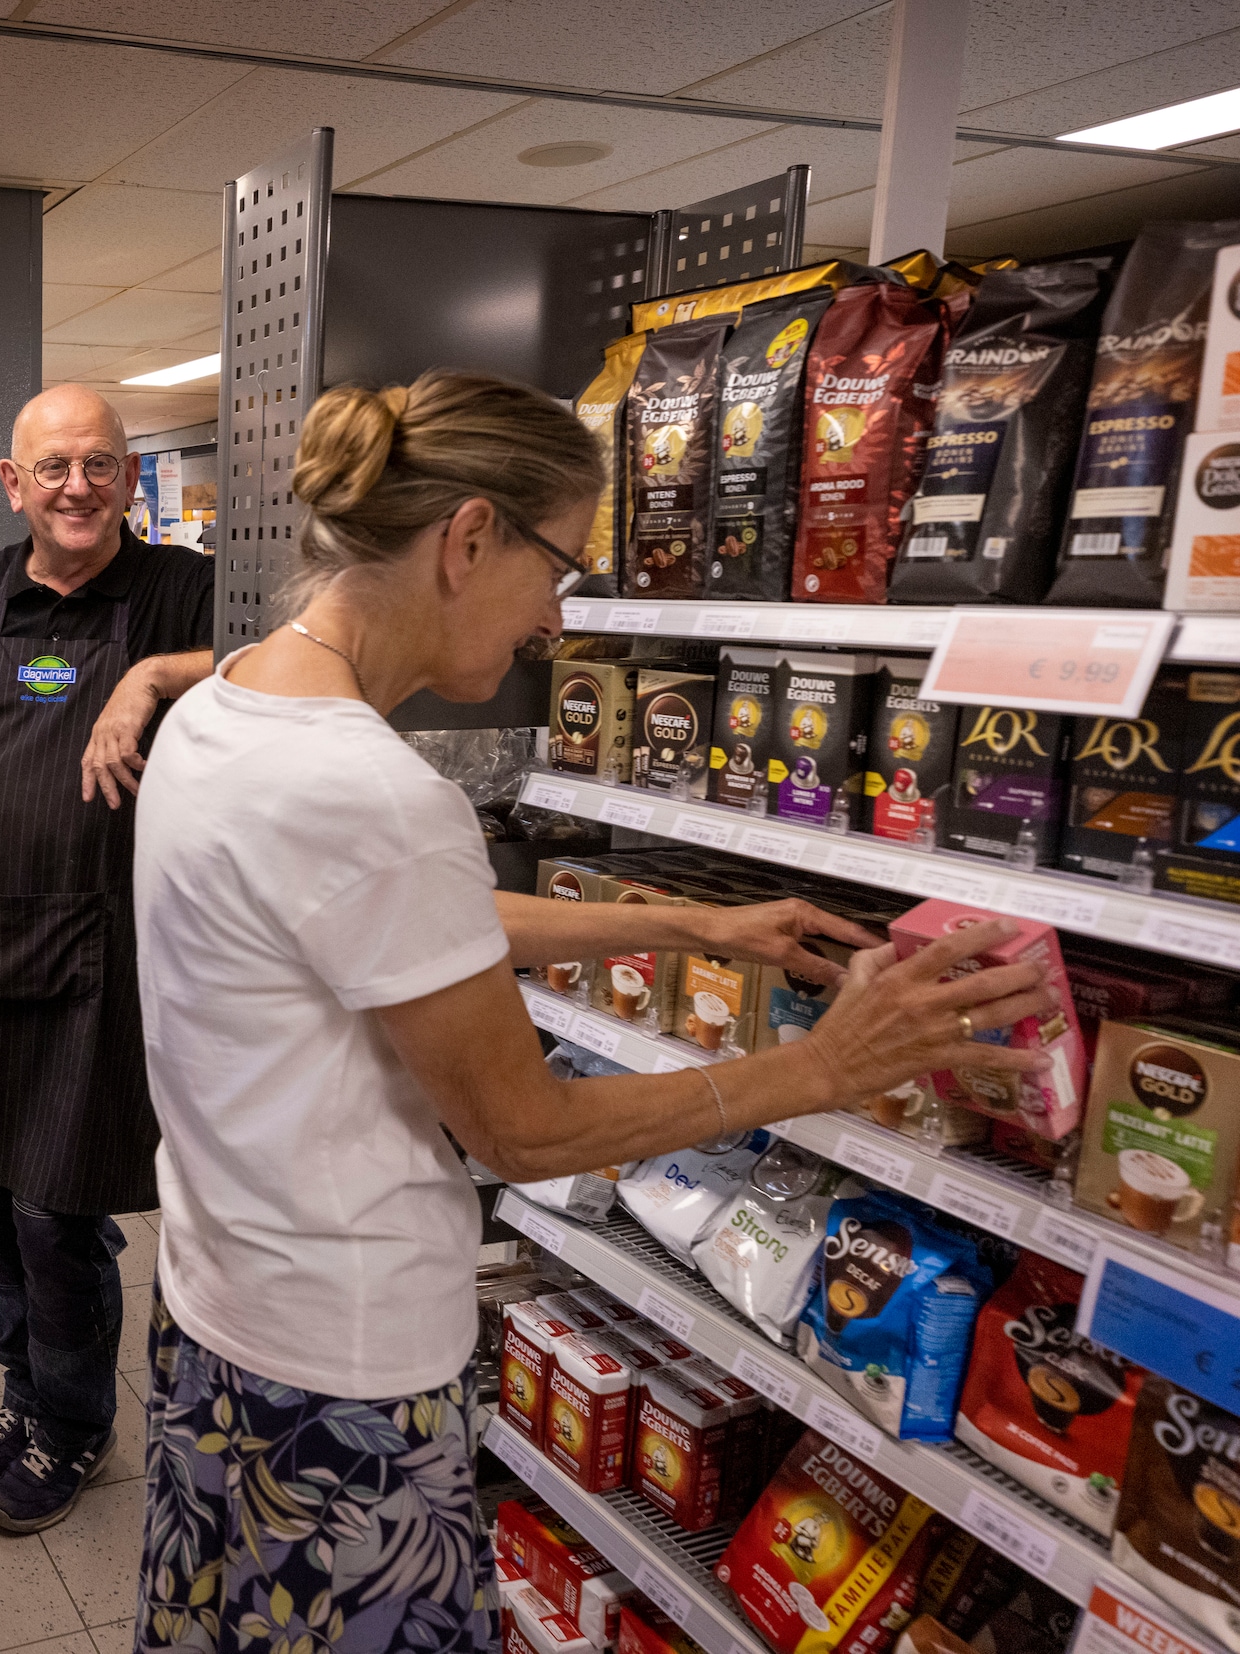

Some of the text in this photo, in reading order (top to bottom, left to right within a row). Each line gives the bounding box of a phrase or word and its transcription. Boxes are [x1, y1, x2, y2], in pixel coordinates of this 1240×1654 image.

[579, 402, 617, 416] DOUW
[1088, 415, 1175, 435] ESPRESSO
[926, 431, 998, 450] ESPRESSO
[720, 472, 757, 484] ESPRESSO
[836, 479, 865, 490] ROOD
[647, 490, 677, 500] INTENS
[649, 500, 674, 509] BONEN
[22, 669, 72, 681] dagwinkel
[1029, 658, 1046, 679] €
[727, 681, 770, 695] EGBERTS
[786, 688, 837, 704] EGBERTS
[565, 712, 594, 725] GOLD
[653, 728, 687, 741] GOLD
[720, 977, 738, 990] LATTE
[790, 1001, 813, 1017] LATTE
[1140, 1077, 1196, 1104] GOLD
[731, 1209, 789, 1264] Strong
[845, 1263, 882, 1292] DECAF
[505, 1339, 542, 1377] EGBERTS
[550, 1378, 591, 1418] EGBERTS
[640, 1410, 692, 1453] EGBERTS
[801, 1454, 888, 1538] EGBERTS
[826, 1519, 912, 1628] FAMILIEPAK
